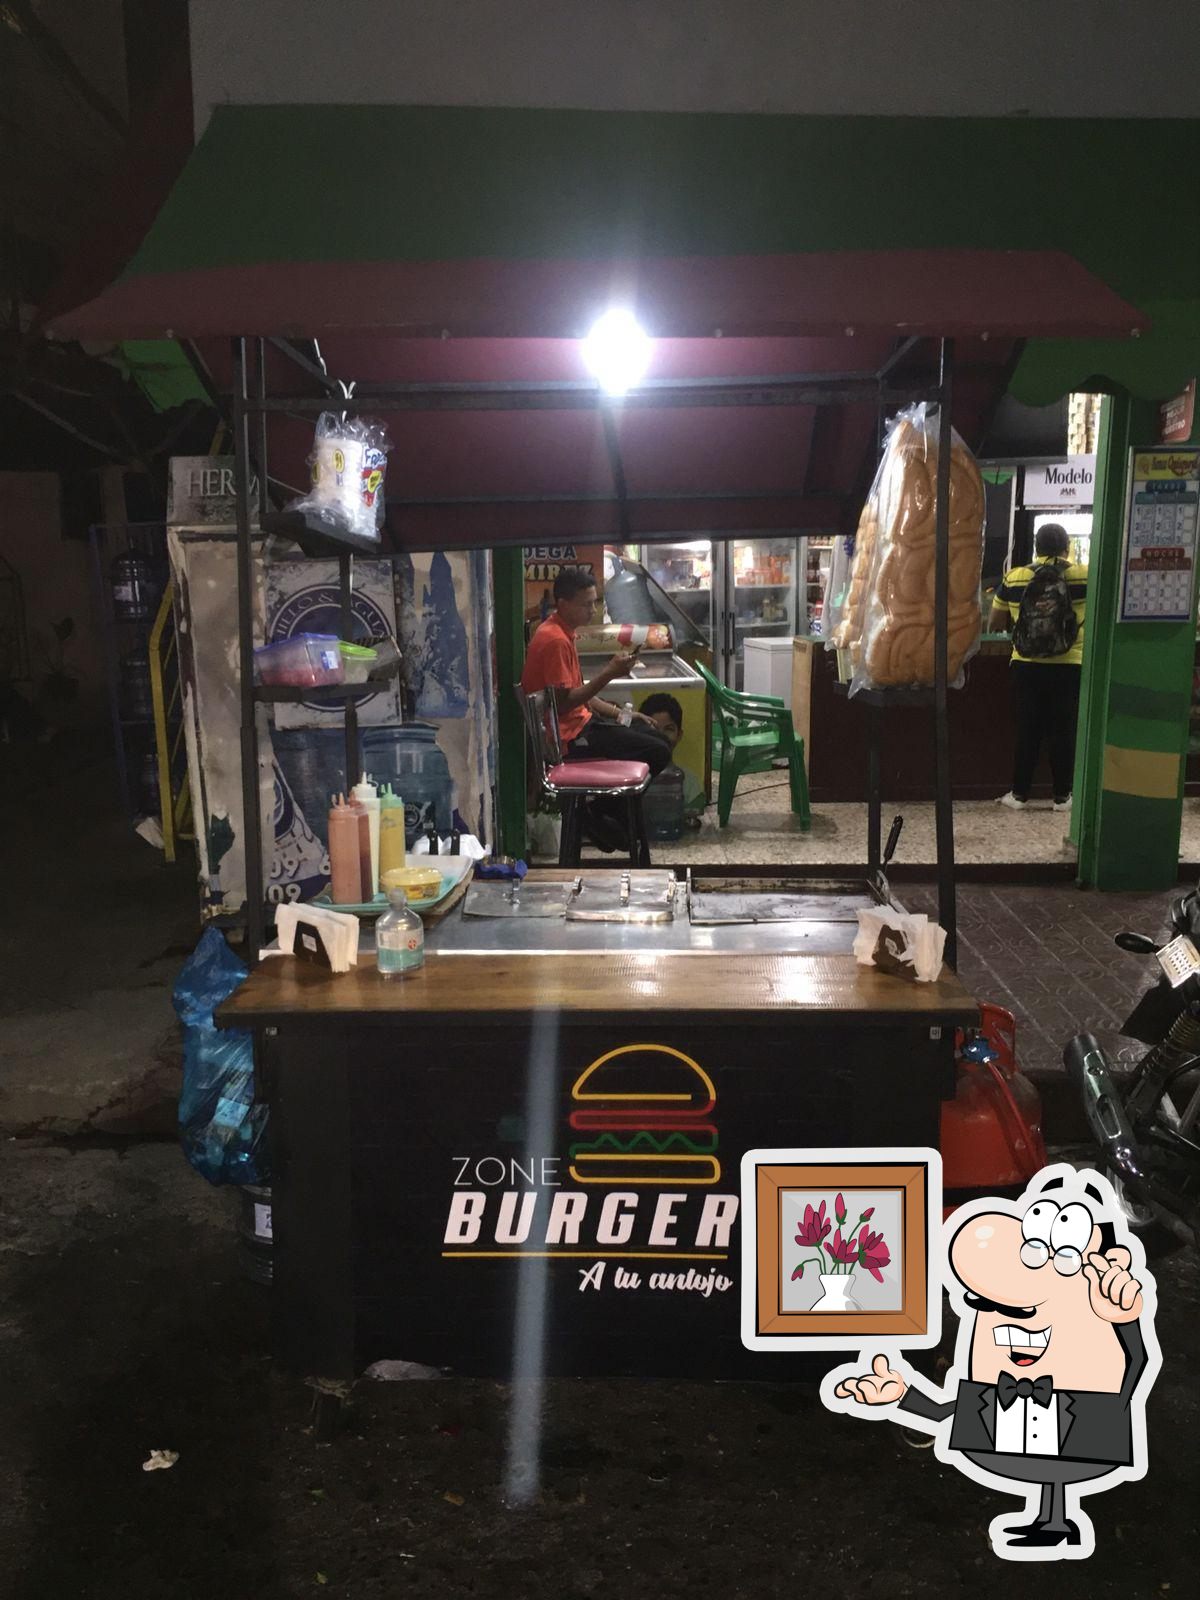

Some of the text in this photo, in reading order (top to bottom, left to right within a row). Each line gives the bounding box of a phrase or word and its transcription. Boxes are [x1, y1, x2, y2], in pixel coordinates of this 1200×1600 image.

[1045, 467, 1092, 484] Modelo
[452, 1156, 562, 1186] ZONE
[443, 1191, 740, 1247] BURGER
[578, 1261, 733, 1298] A tu antojo
